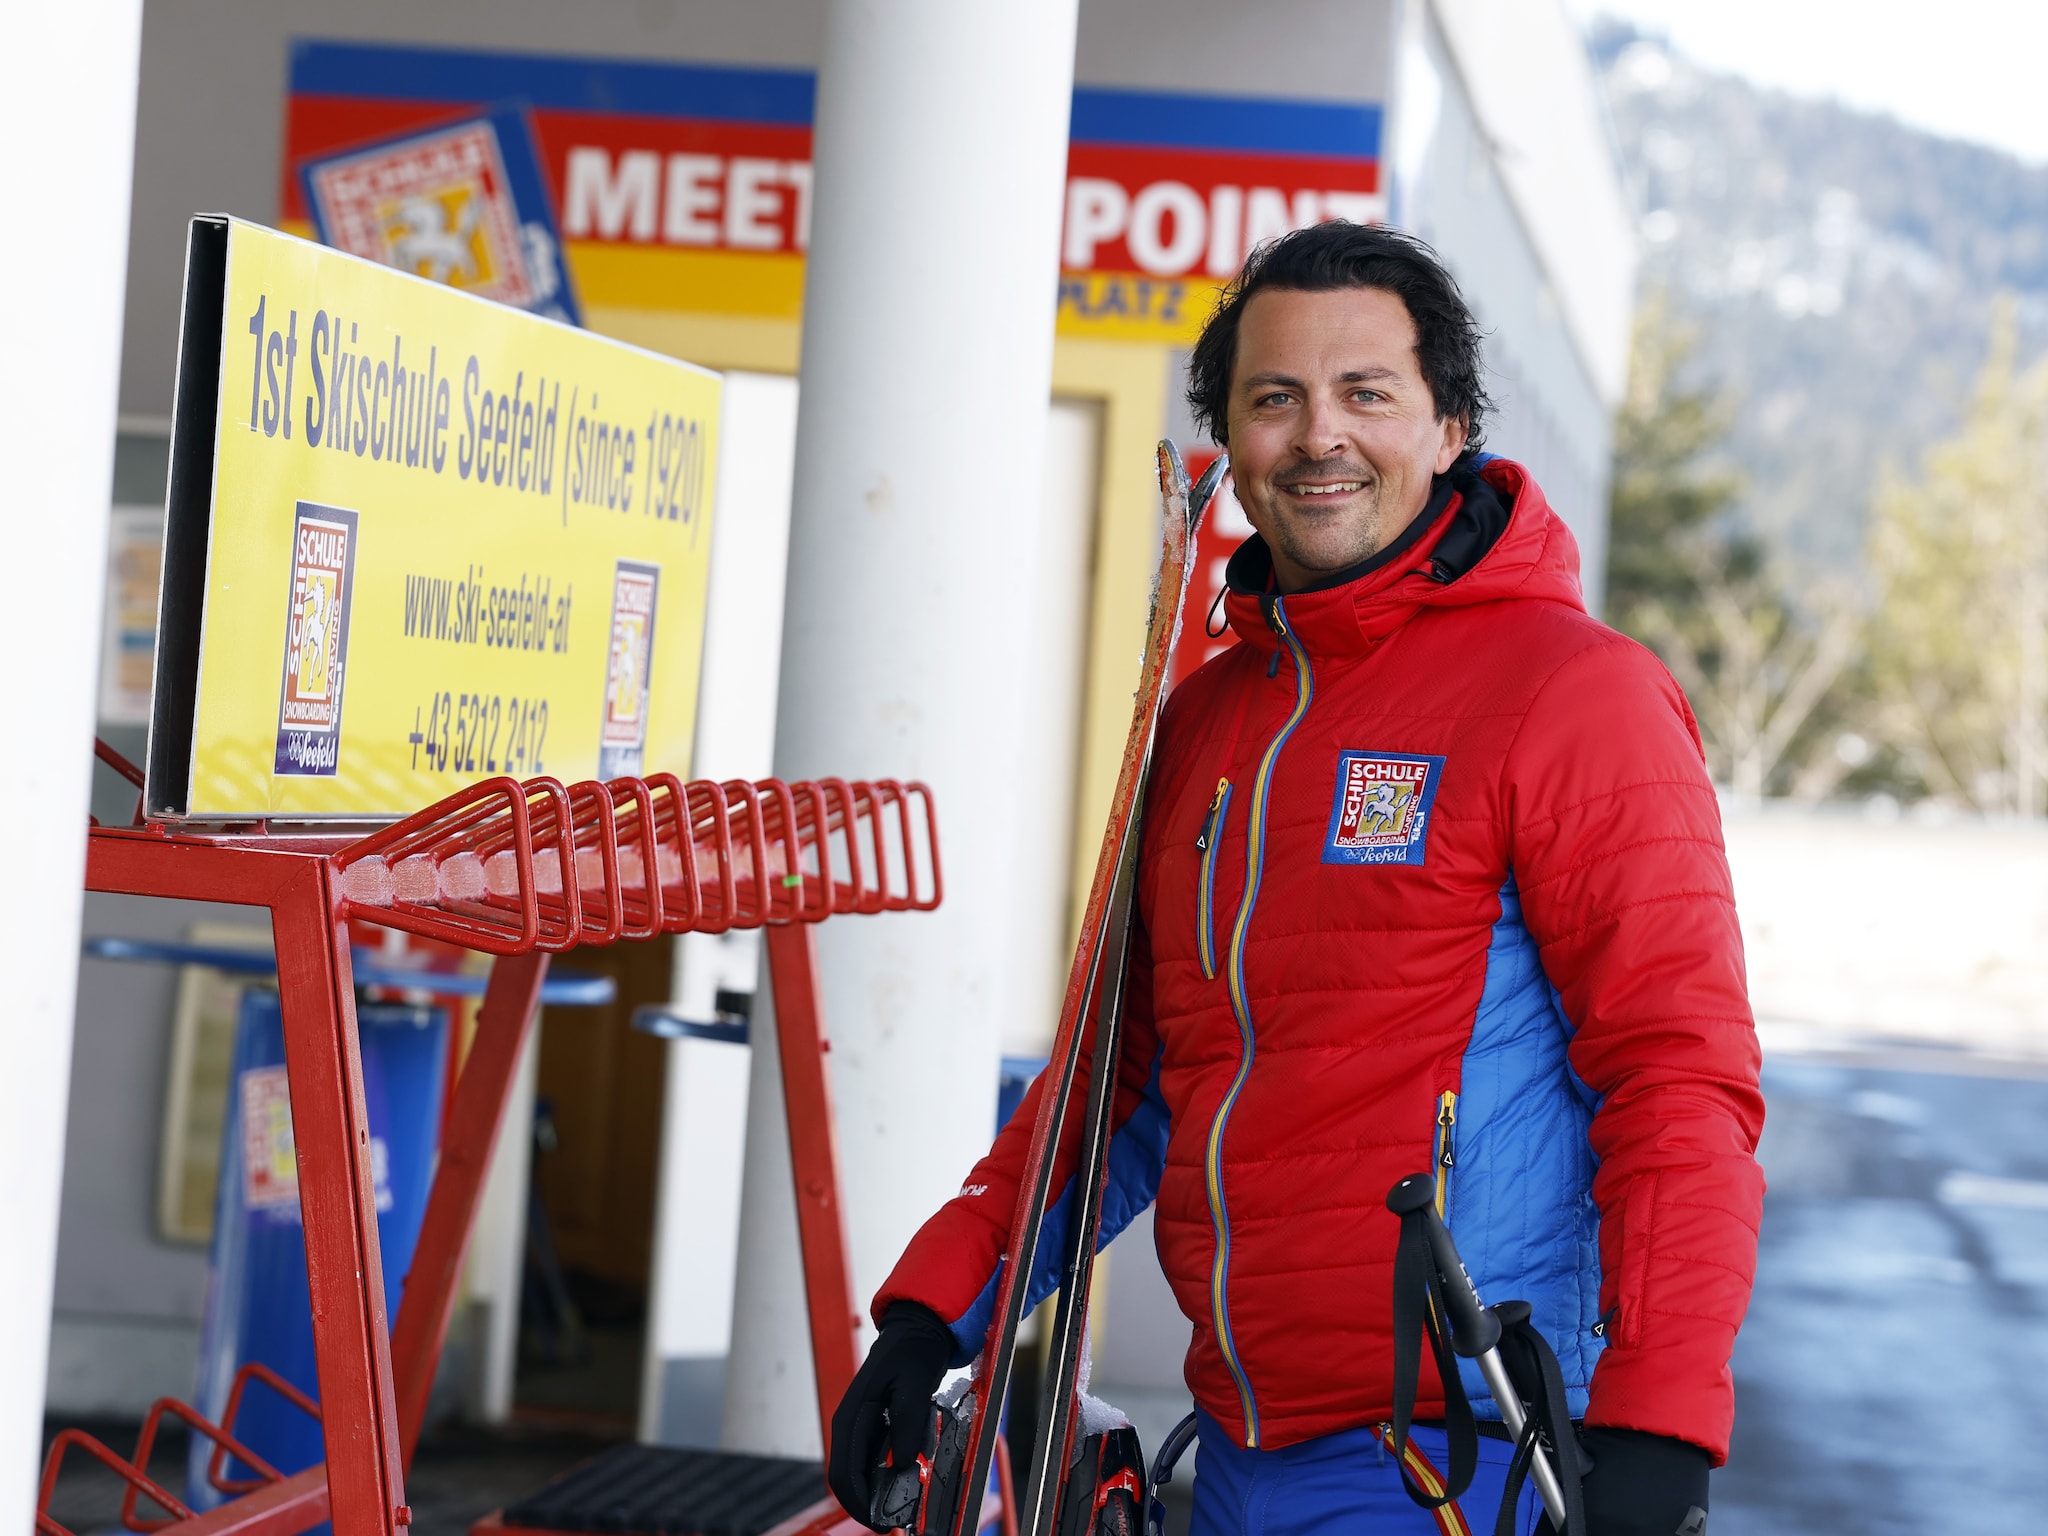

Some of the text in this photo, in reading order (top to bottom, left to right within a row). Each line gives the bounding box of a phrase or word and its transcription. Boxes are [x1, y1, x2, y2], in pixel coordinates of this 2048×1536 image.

[1062, 176, 1386, 277] POIN
[249, 294, 706, 552] 1st Skischule Seefeld (since 1920)
[299, 528, 345, 569] SCHULE
[289, 567, 307, 675] SCHI
[326, 599, 340, 697] CARVING
[285, 701, 330, 722] SNOWBOARDING
[409, 692, 451, 773] +43
[454, 693, 501, 773] 5212
[504, 696, 549, 774] 2412
[299, 731, 336, 773] Seefeld
[1351, 763, 1425, 781] SCHULE
[1344, 780, 1364, 827] SCHI
[1402, 795, 1419, 834] CARVING
[1338, 836, 1406, 846] SNOWBOARDING
[1360, 846, 1408, 864] Seefeld
[1459, 1262, 1485, 1311] LEKI
